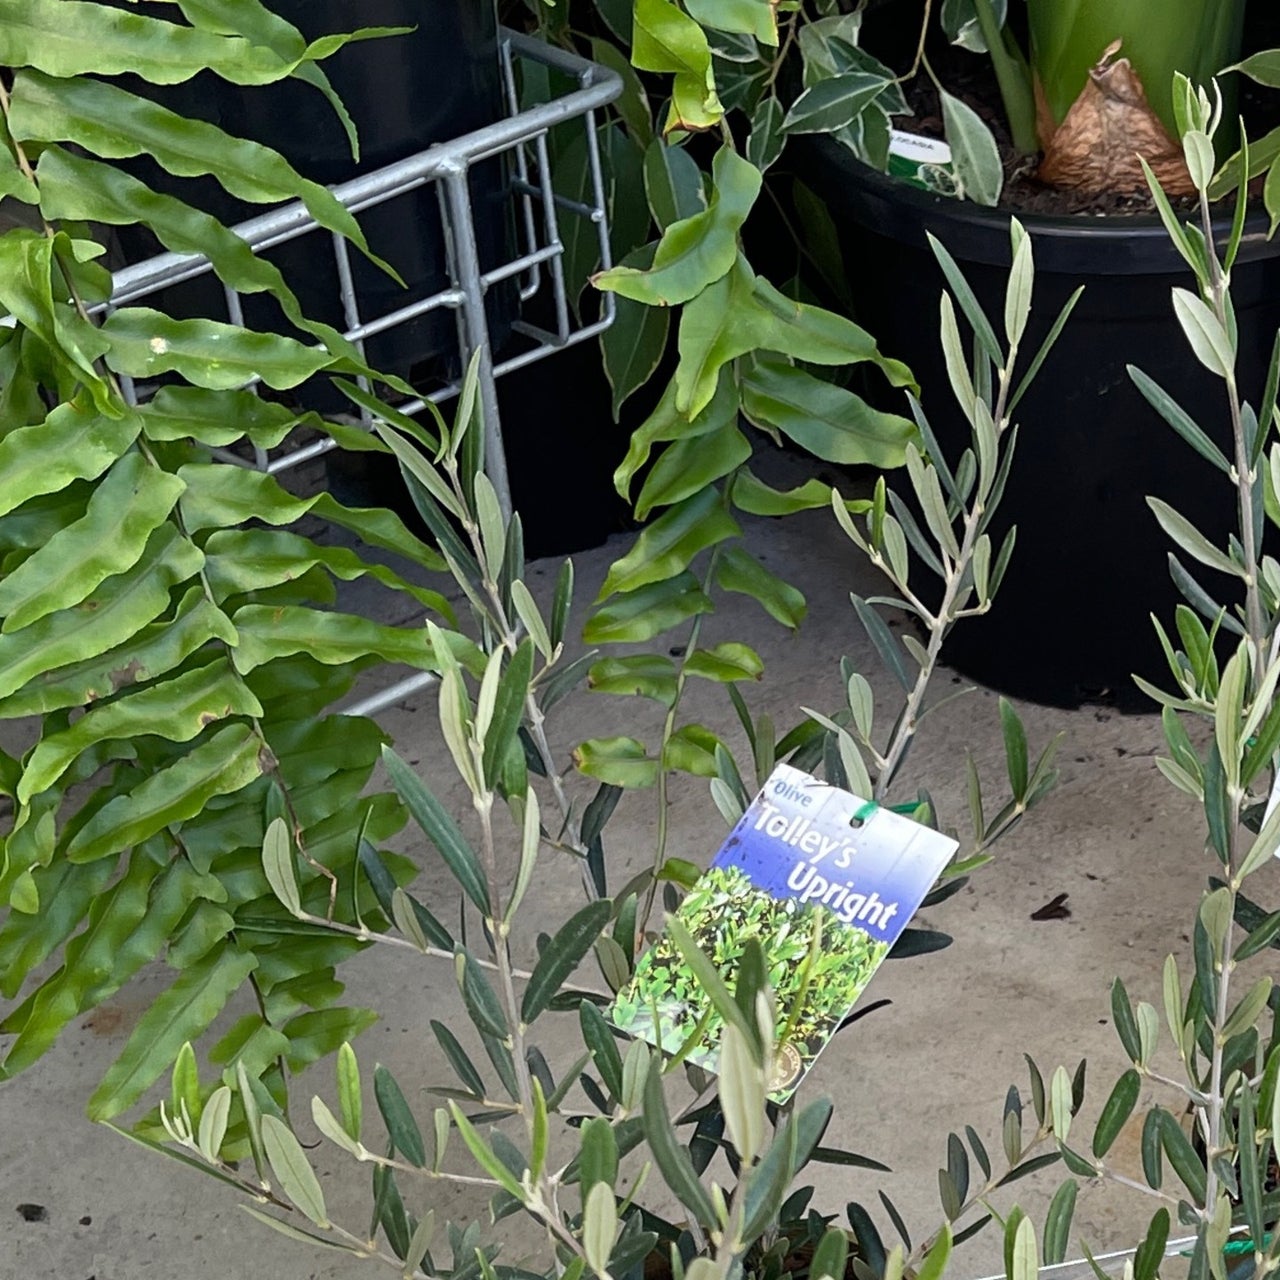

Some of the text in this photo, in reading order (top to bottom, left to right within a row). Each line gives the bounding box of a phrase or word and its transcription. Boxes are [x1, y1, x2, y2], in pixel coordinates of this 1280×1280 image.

[773, 781, 814, 809] Olive
[754, 802, 858, 870] Tolley's
[787, 861, 898, 932] Upright
